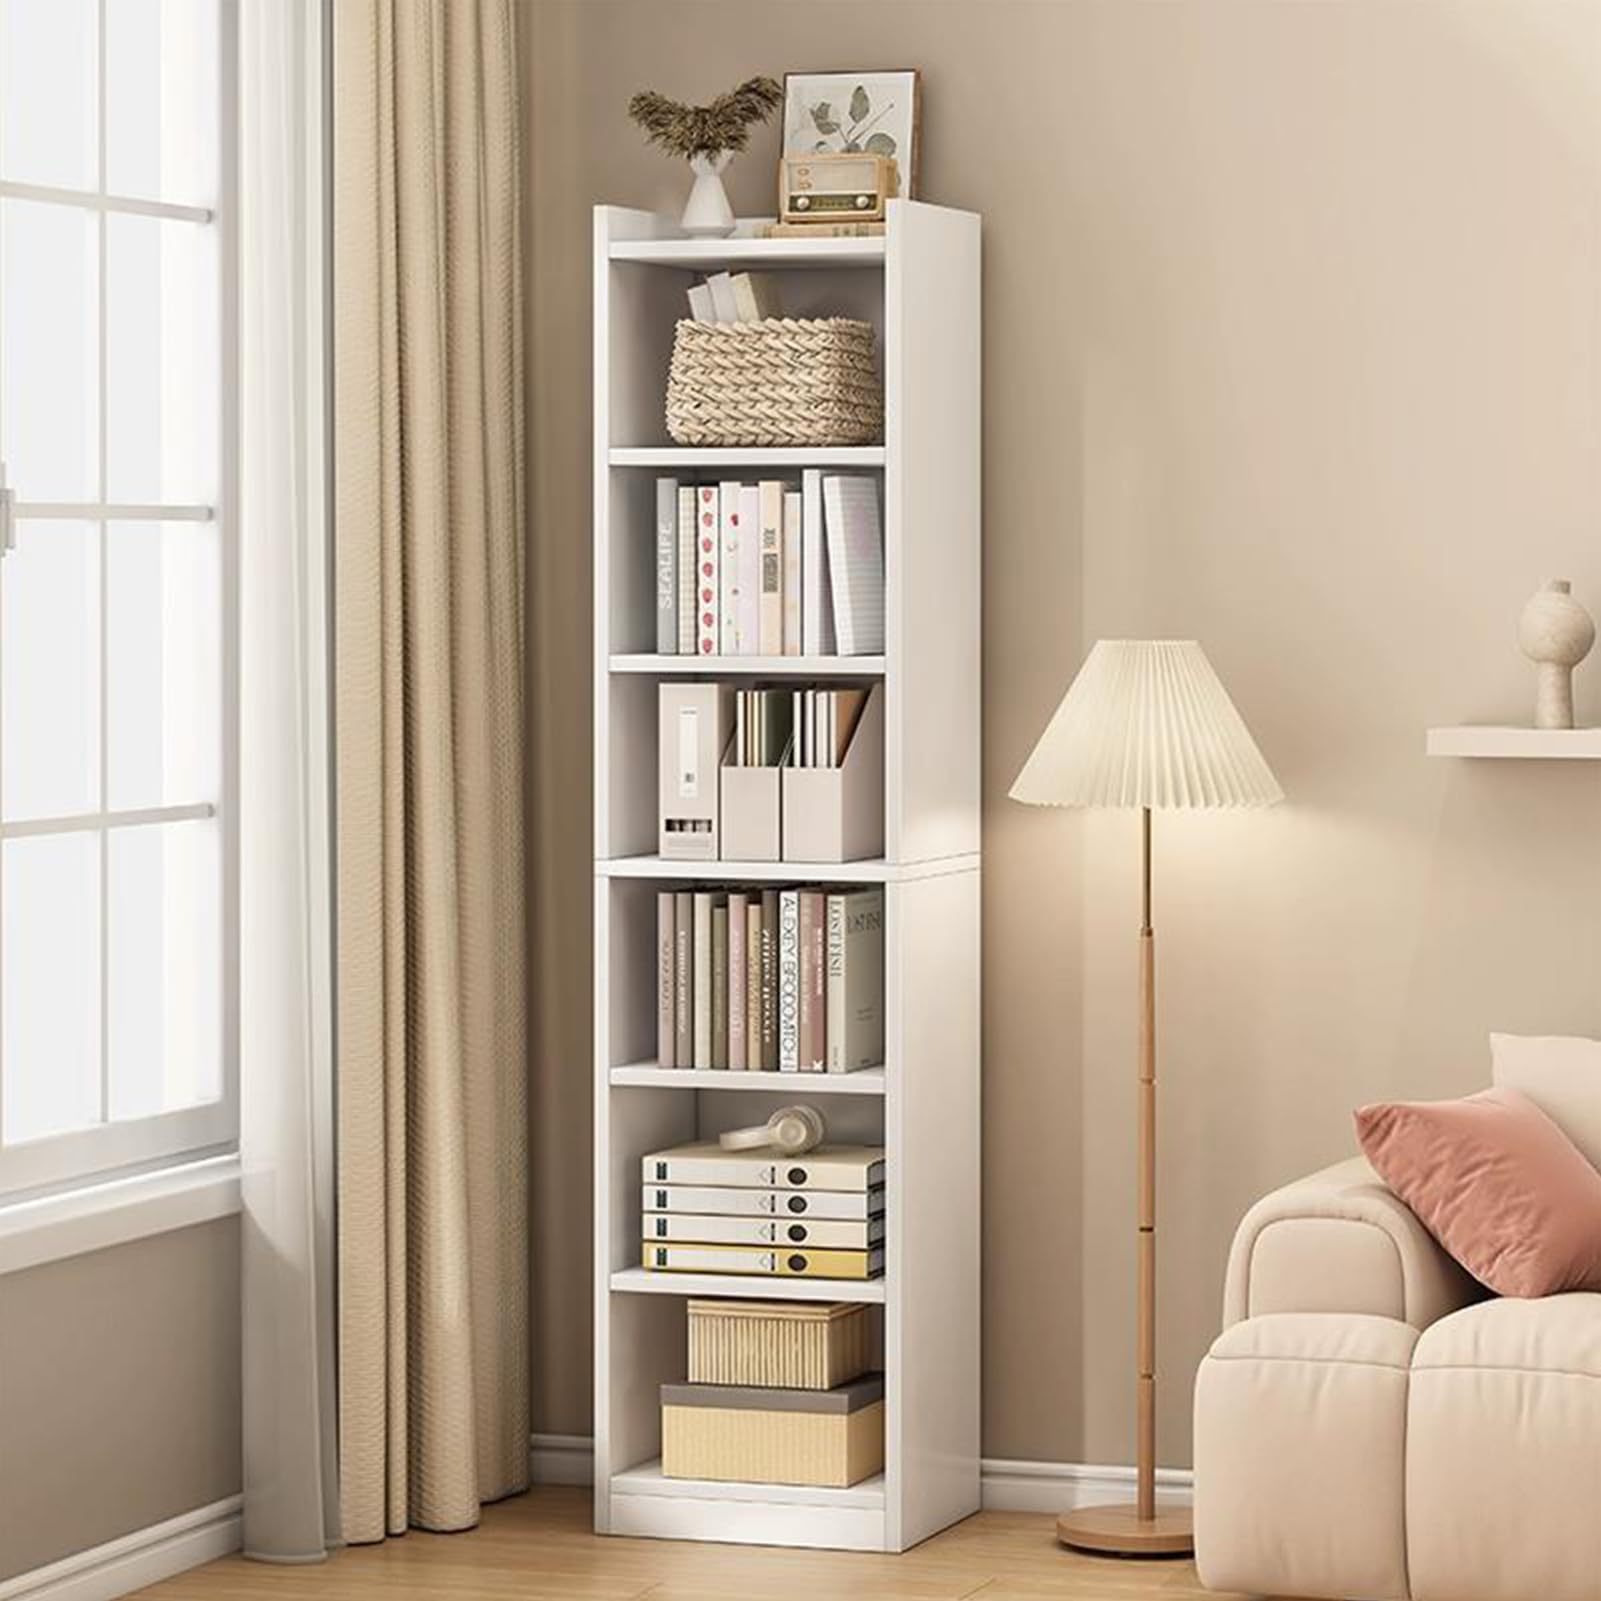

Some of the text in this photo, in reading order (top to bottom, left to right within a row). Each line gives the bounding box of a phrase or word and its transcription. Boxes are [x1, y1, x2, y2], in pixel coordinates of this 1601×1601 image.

[782, 897, 797, 960] ALEXEY
[830, 900, 842, 977] LOST FISH
